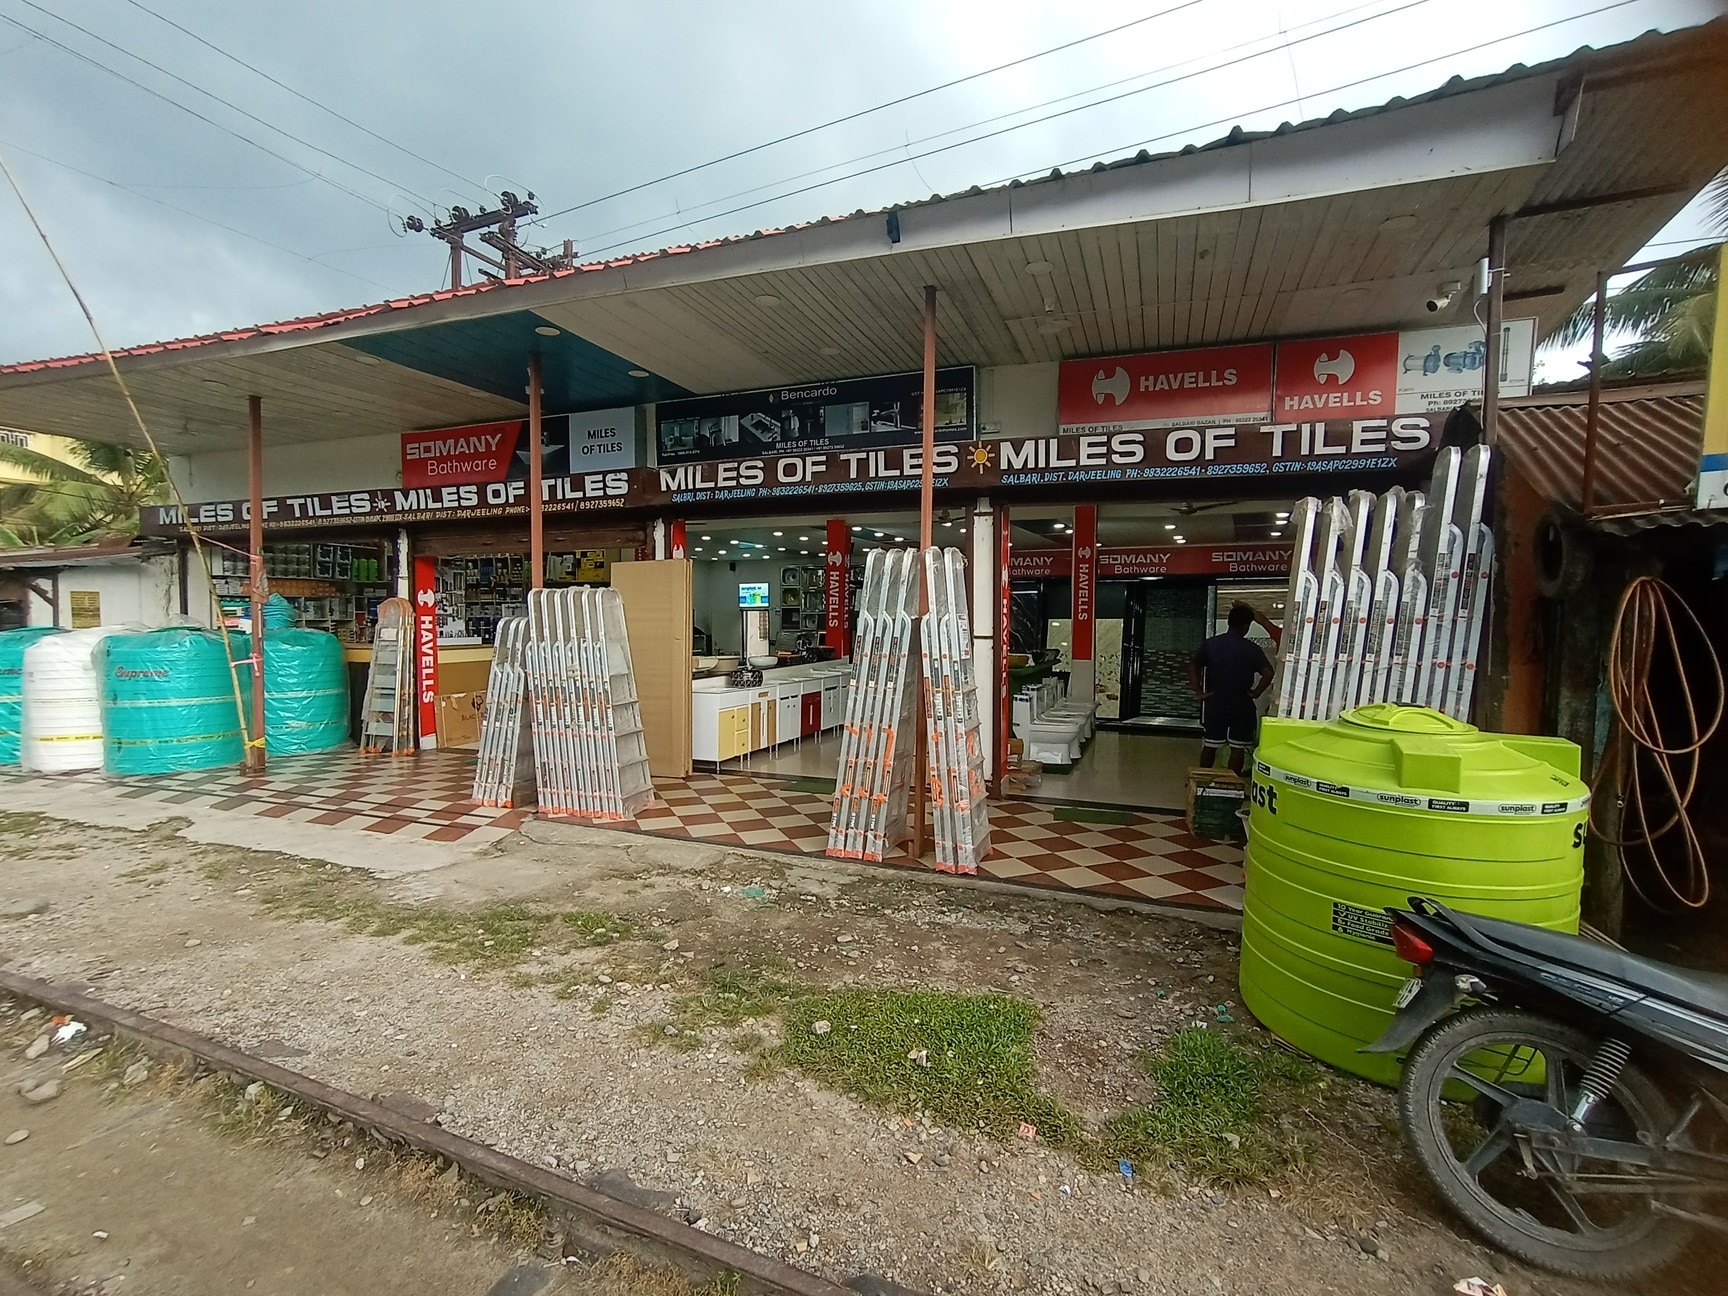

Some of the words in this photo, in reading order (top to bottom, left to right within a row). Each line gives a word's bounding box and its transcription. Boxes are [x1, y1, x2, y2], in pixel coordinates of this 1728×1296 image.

[1139, 369, 1238, 391] HAVELLS
[781, 386, 837, 401] Bencardo
[1284, 390, 1382, 410] HAVELLS
[587, 428, 616, 440] MILES
[406, 434, 502, 460] SOMANY
[581, 444, 596, 455] OF
[597, 443, 623, 453] TILES
[999, 433, 1145, 471] MILES
[1165, 427, 1236, 462] OF
[1259, 416, 1431, 458] TILES
[427, 458, 498, 476] Bathware
[659, 460, 765, 491] MILES
[777, 455, 827, 483] OF
[840, 444, 959, 479] TILES
[1068, 469, 1121, 481] DARJEELING
[394, 485, 478, 511] MILES
[486, 482, 524, 505] OF
[541, 472, 629, 501] TILES
[714, 488, 756, 500] DARJEELING
[159, 503, 234, 525] MILES
[286, 493, 371, 518] TILES
[457, 507, 503, 518] DARJEELING
[1010, 556, 1054, 566] MANY
[1100, 553, 1172, 565] SOMANY
[1211, 550, 1293, 563] SOMANY
[1011, 567, 1051, 575] athware
[1114, 563, 1167, 573] Bathware
[1229, 561, 1288, 572] Bathware
[829, 571, 840, 628] HAVELLS
[1079, 564, 1089, 621] HAVELLS
[420, 615, 435, 704] HAVELLS
[1379, 794, 1420, 806] sunplast
[1500, 804, 1535, 813] sunplast
[1337, 903, 1346, 911] 10
[1348, 906, 1364, 915] Year
[1364, 909, 1394, 922] Guaran
[1347, 921, 1364, 930] Food
[1365, 924, 1390, 936] Grade
